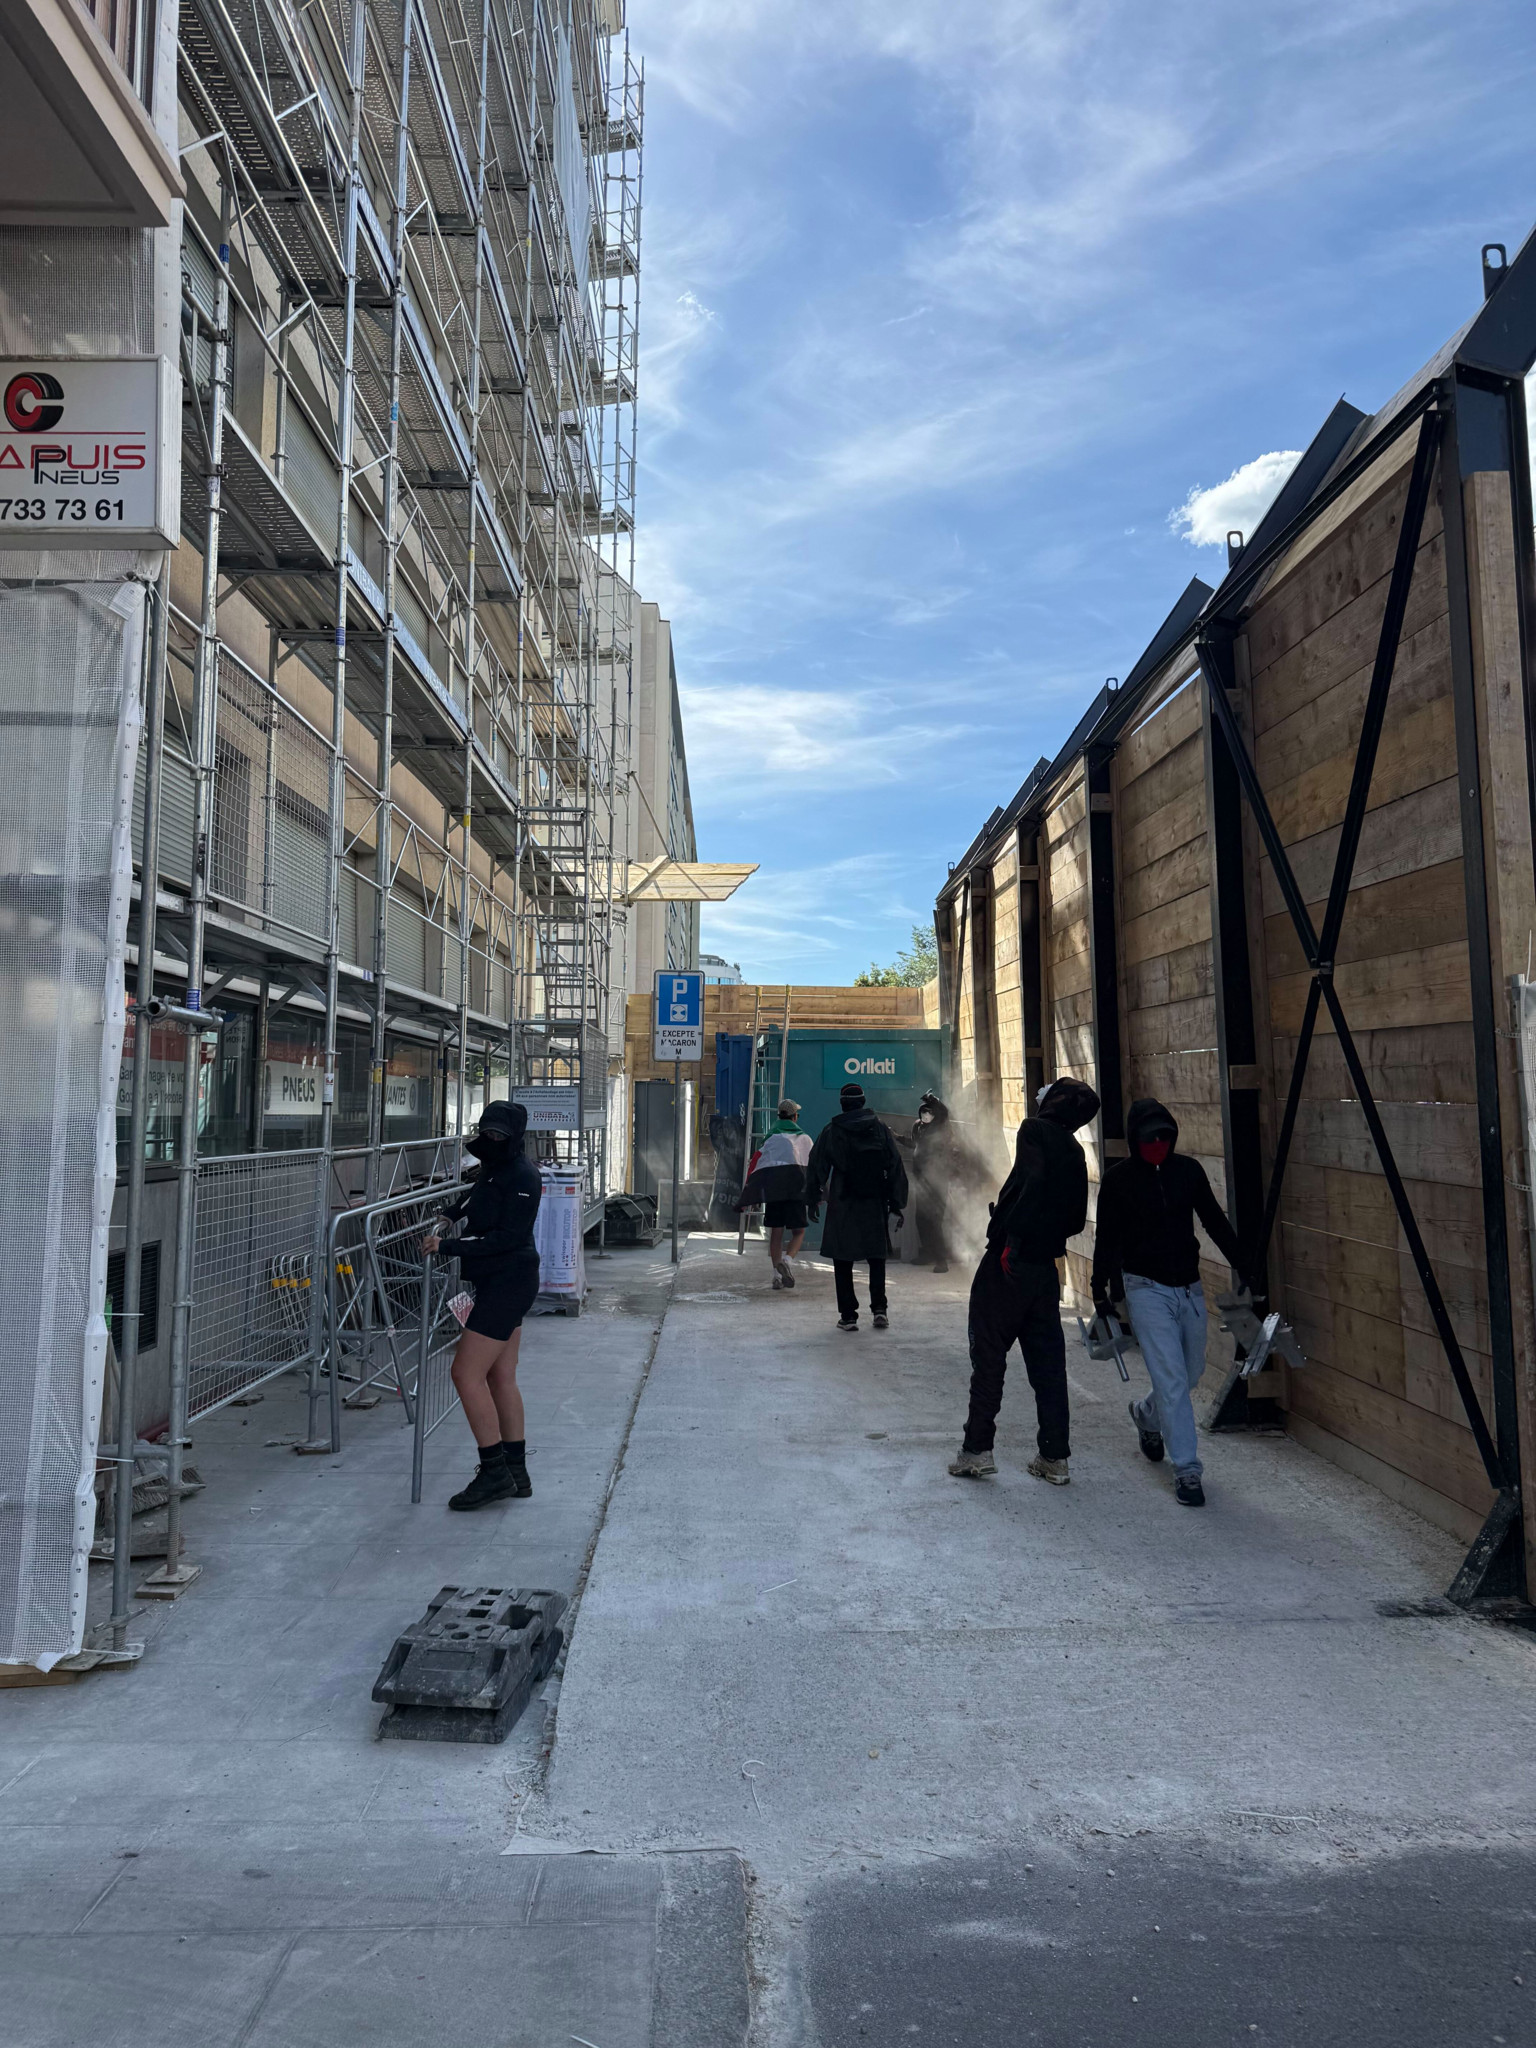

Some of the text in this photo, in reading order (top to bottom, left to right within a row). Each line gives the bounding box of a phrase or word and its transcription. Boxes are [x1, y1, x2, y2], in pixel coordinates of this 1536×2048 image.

[0, 499, 124, 521] 733 73 61
[672, 979, 688, 1003] P
[662, 1030, 695, 1038] EXCEPTE
[844, 1057, 896, 1075] Orllati
[282, 1076, 315, 1102] PNEUS
